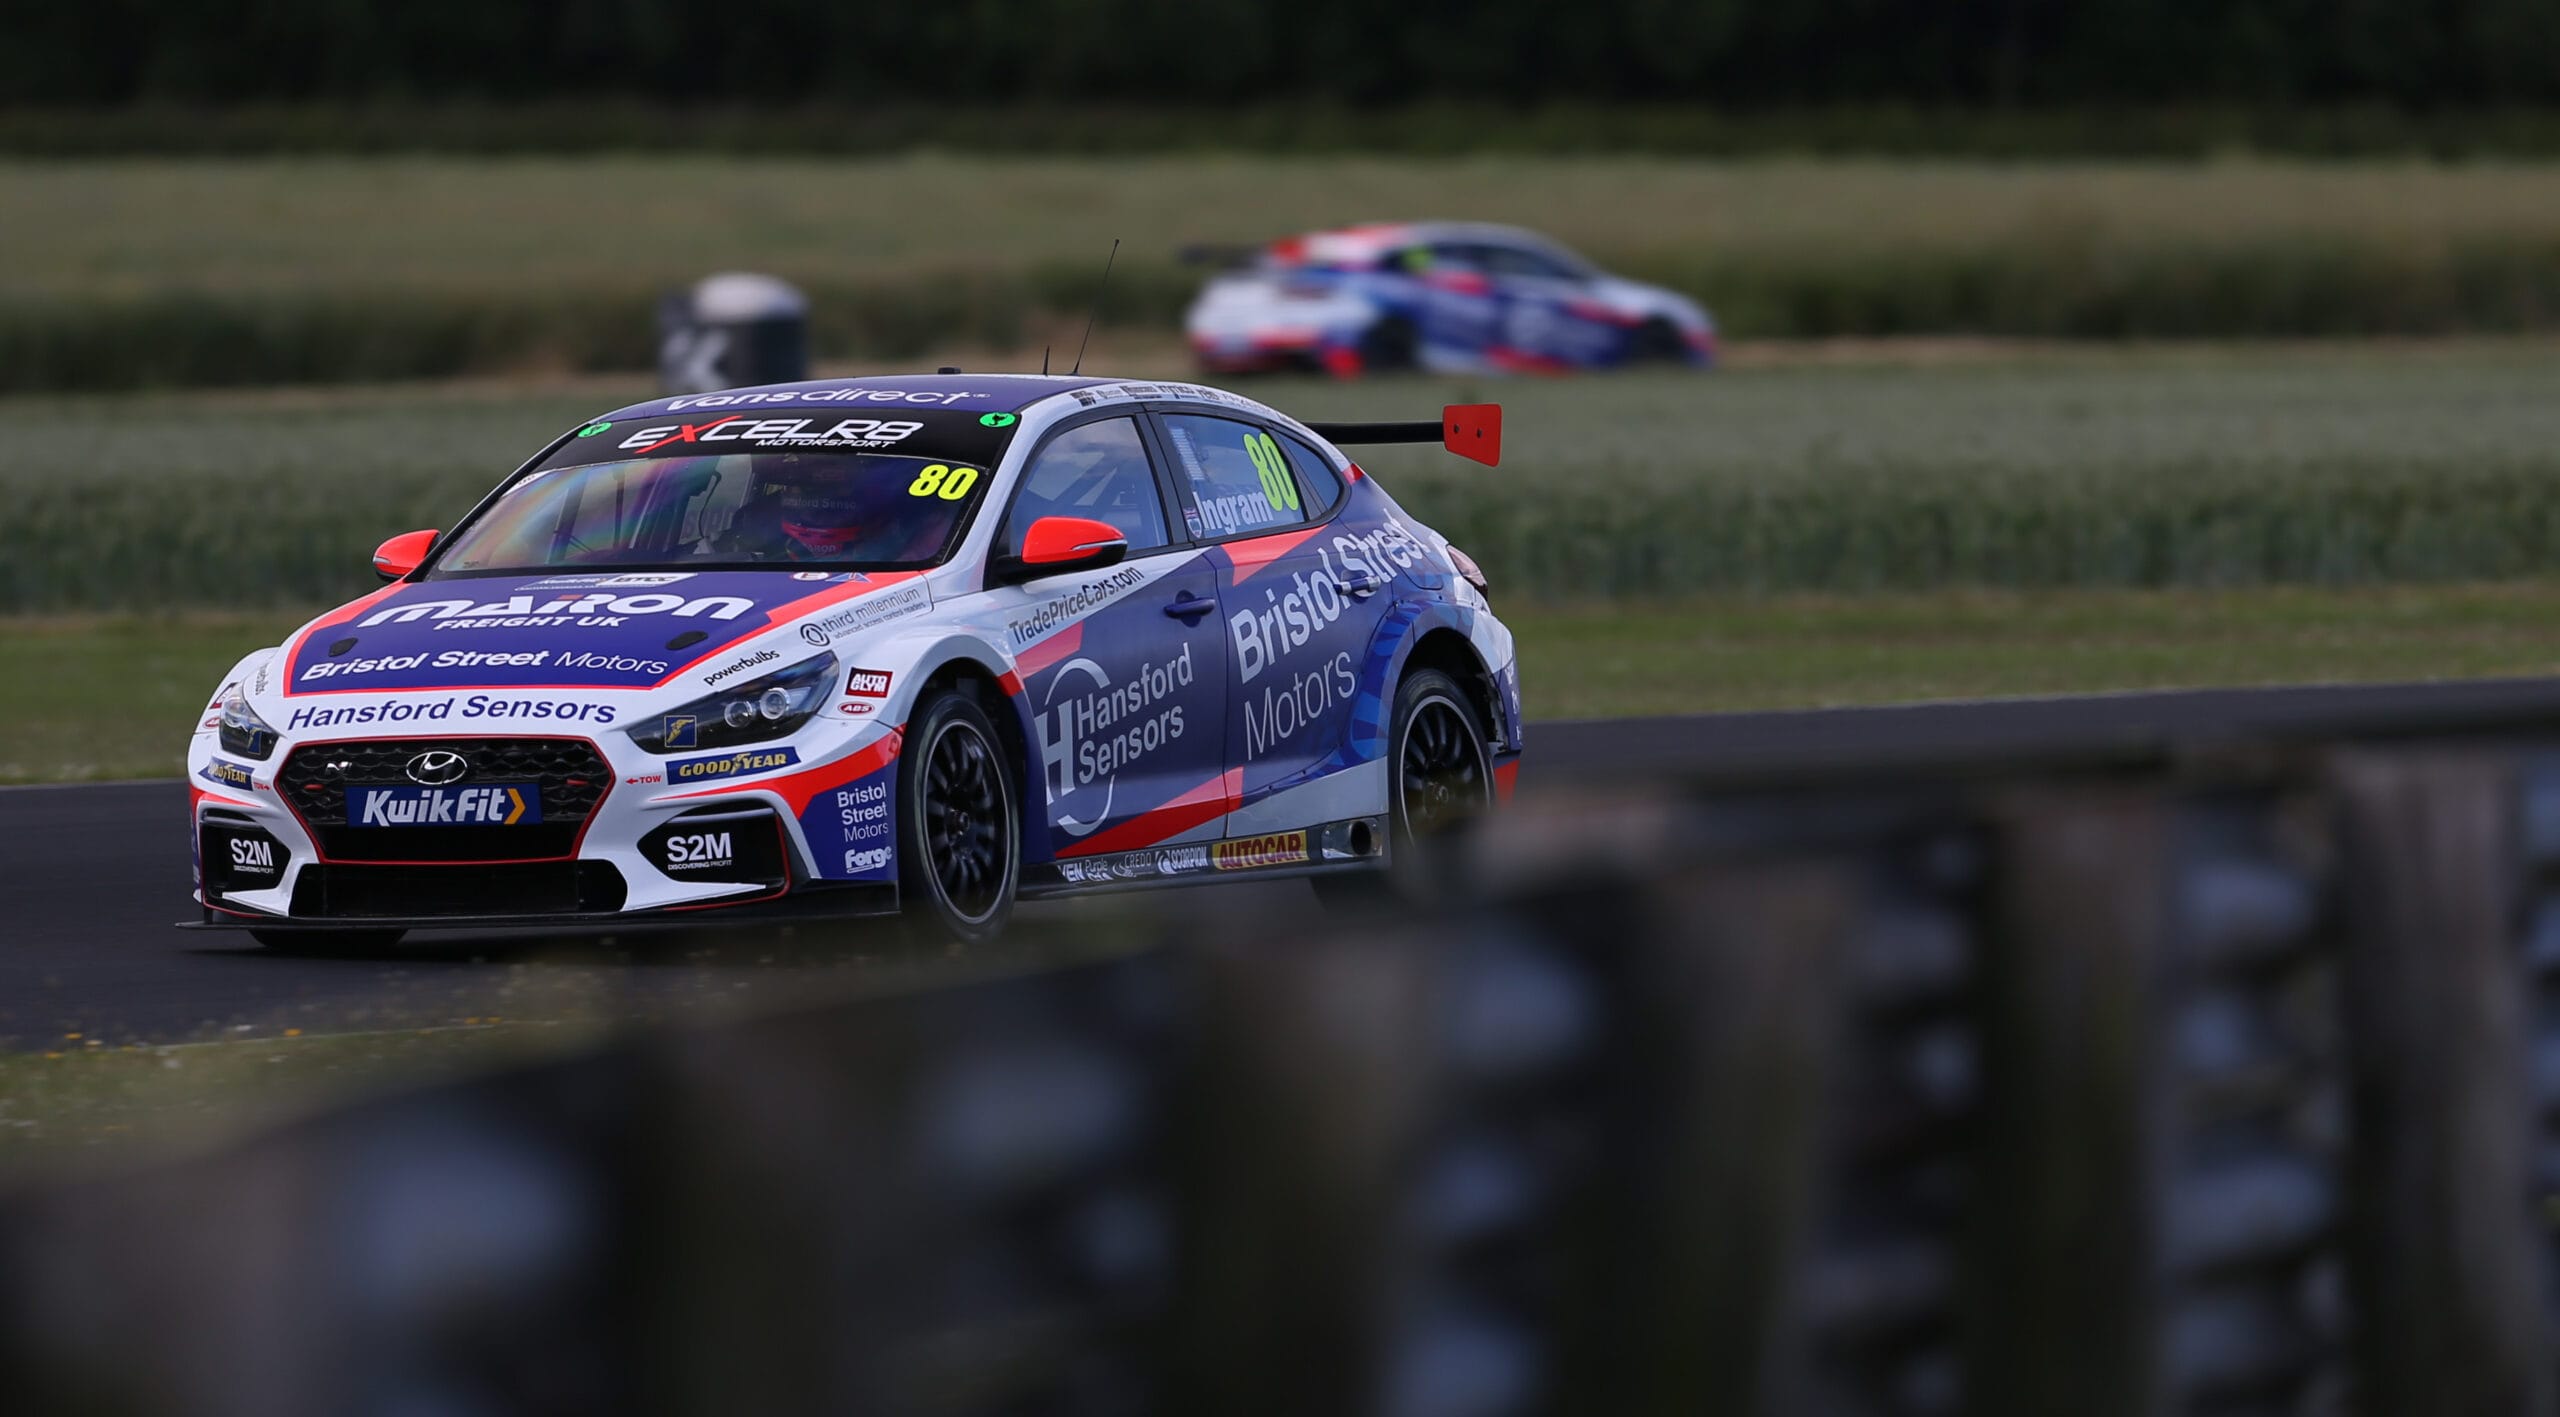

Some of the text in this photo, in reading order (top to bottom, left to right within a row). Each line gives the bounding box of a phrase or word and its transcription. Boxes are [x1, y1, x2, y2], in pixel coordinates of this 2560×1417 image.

[667, 388, 970, 411] vansdirect
[618, 415, 924, 454] EXCELR8
[755, 437, 897, 449] MOTORSPORT
[908, 464, 979, 501] 80
[1243, 433, 1299, 512] 80
[1192, 491, 1274, 535] Ingram
[822, 588, 920, 632] third millennium
[1009, 566, 1144, 645] TradePriceCars.com
[1230, 508, 1431, 684] Bristol Street
[433, 616, 628, 631] FREIGHT UK
[301, 650, 668, 681] Bristol Street Motors
[703, 648, 780, 686] powerbulbs
[851, 673, 887, 683] AUTO
[849, 681, 885, 692] GLYM
[1077, 642, 1193, 740] Hansford
[287, 695, 616, 731] Hansford Sensors
[1244, 651, 1355, 761] Motors
[1079, 706, 1184, 784] Sensors
[678, 752, 787, 777] GOODYEAR
[640, 776, 661, 784] TOW
[837, 782, 887, 808] Bristol
[841, 801, 888, 825] Street
[667, 832, 732, 862] S2M
[844, 822, 889, 842] Motors
[231, 838, 273, 867] S2M
[1085, 859, 1108, 873] Purple
[1124, 852, 1152, 868] CREDO
[1171, 847, 1208, 870] SCORPION
[1219, 834, 1305, 868] AUTOCAR
